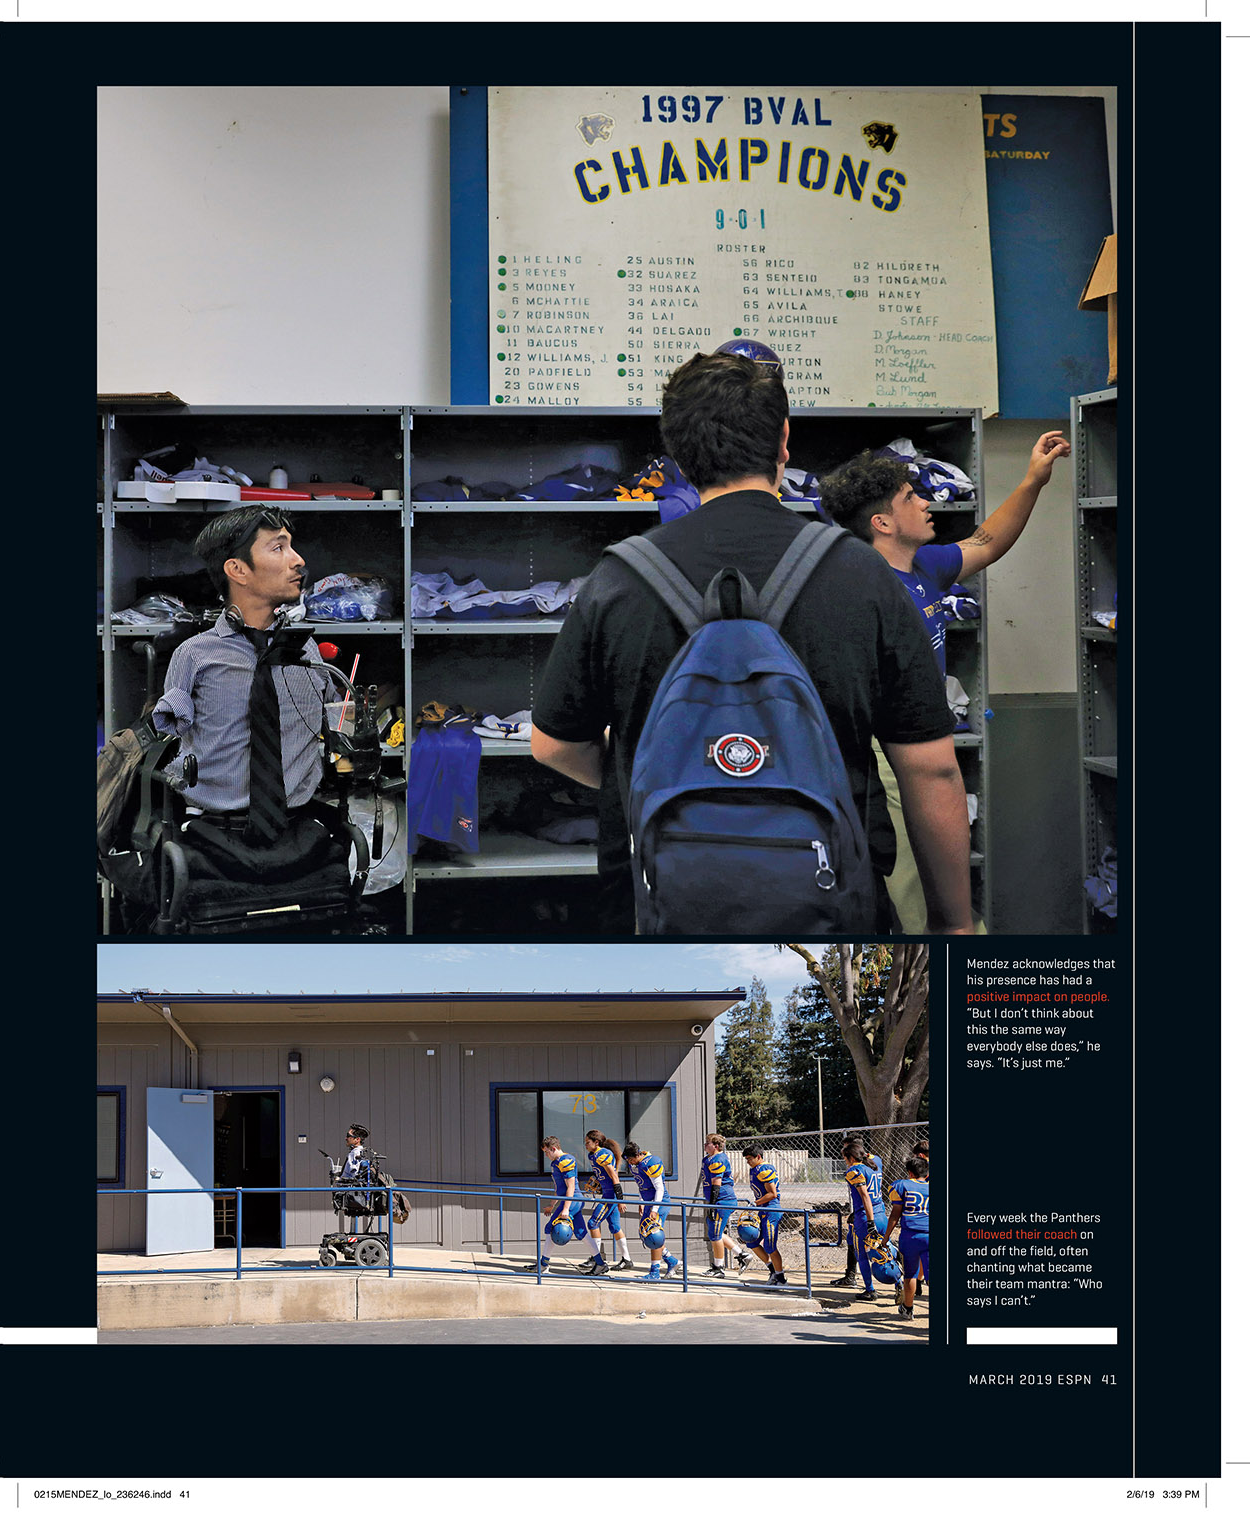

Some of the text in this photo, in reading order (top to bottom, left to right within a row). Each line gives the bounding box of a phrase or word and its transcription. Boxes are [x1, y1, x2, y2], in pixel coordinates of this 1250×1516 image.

[642, 95, 832, 126] 1997 BVAL
[573, 137, 908, 212] CHAMPIONS
[717, 244, 765, 253] ROSTER
[524, 256, 581, 264] HELING
[627, 256, 694, 265] 25 AUSTIN
[743, 259, 794, 268] 56 RICO
[877, 263, 939, 272] HILDRETH
[526, 268, 566, 277] REYES
[628, 270, 696, 279] 32 SUAREZ
[743, 273, 817, 282] 63 SENTEIO
[854, 275, 869, 283] 83
[513, 283, 575, 291] 5 MOONEY
[628, 284, 700, 293] 33 HOSAKA
[879, 291, 920, 299] HANEY
[526, 297, 589, 305] MCHATTIE
[628, 298, 698, 307] 34 ARAICA
[744, 301, 807, 310] 65 AVILA
[879, 305, 921, 313] STOWE
[527, 311, 589, 319] ROBINSON
[628, 312, 673, 320] 36 LAI
[744, 314, 759, 322] 66
[901, 316, 938, 326] STAFF
[507, 325, 603, 334] 10 MACARTNEY
[628, 326, 710, 335] 44 DELGADO
[743, 328, 759, 336] 67
[939, 333, 962, 342] HEAD
[508, 339, 577, 347] 11 BAUCUS
[628, 340, 700, 349] 50 SIERRA
[508, 353, 520, 361] 12
[628, 354, 683, 363] 51 KING
[505, 367, 591, 376] 20 PADFIELD
[628, 369, 643, 377] 53
[505, 381, 579, 390] 23 GOWENS
[628, 383, 643, 391] 54
[503, 395, 579, 405] 24 MALLOY
[627, 398, 643, 407] 55
[569, 1094, 597, 1114] 73
